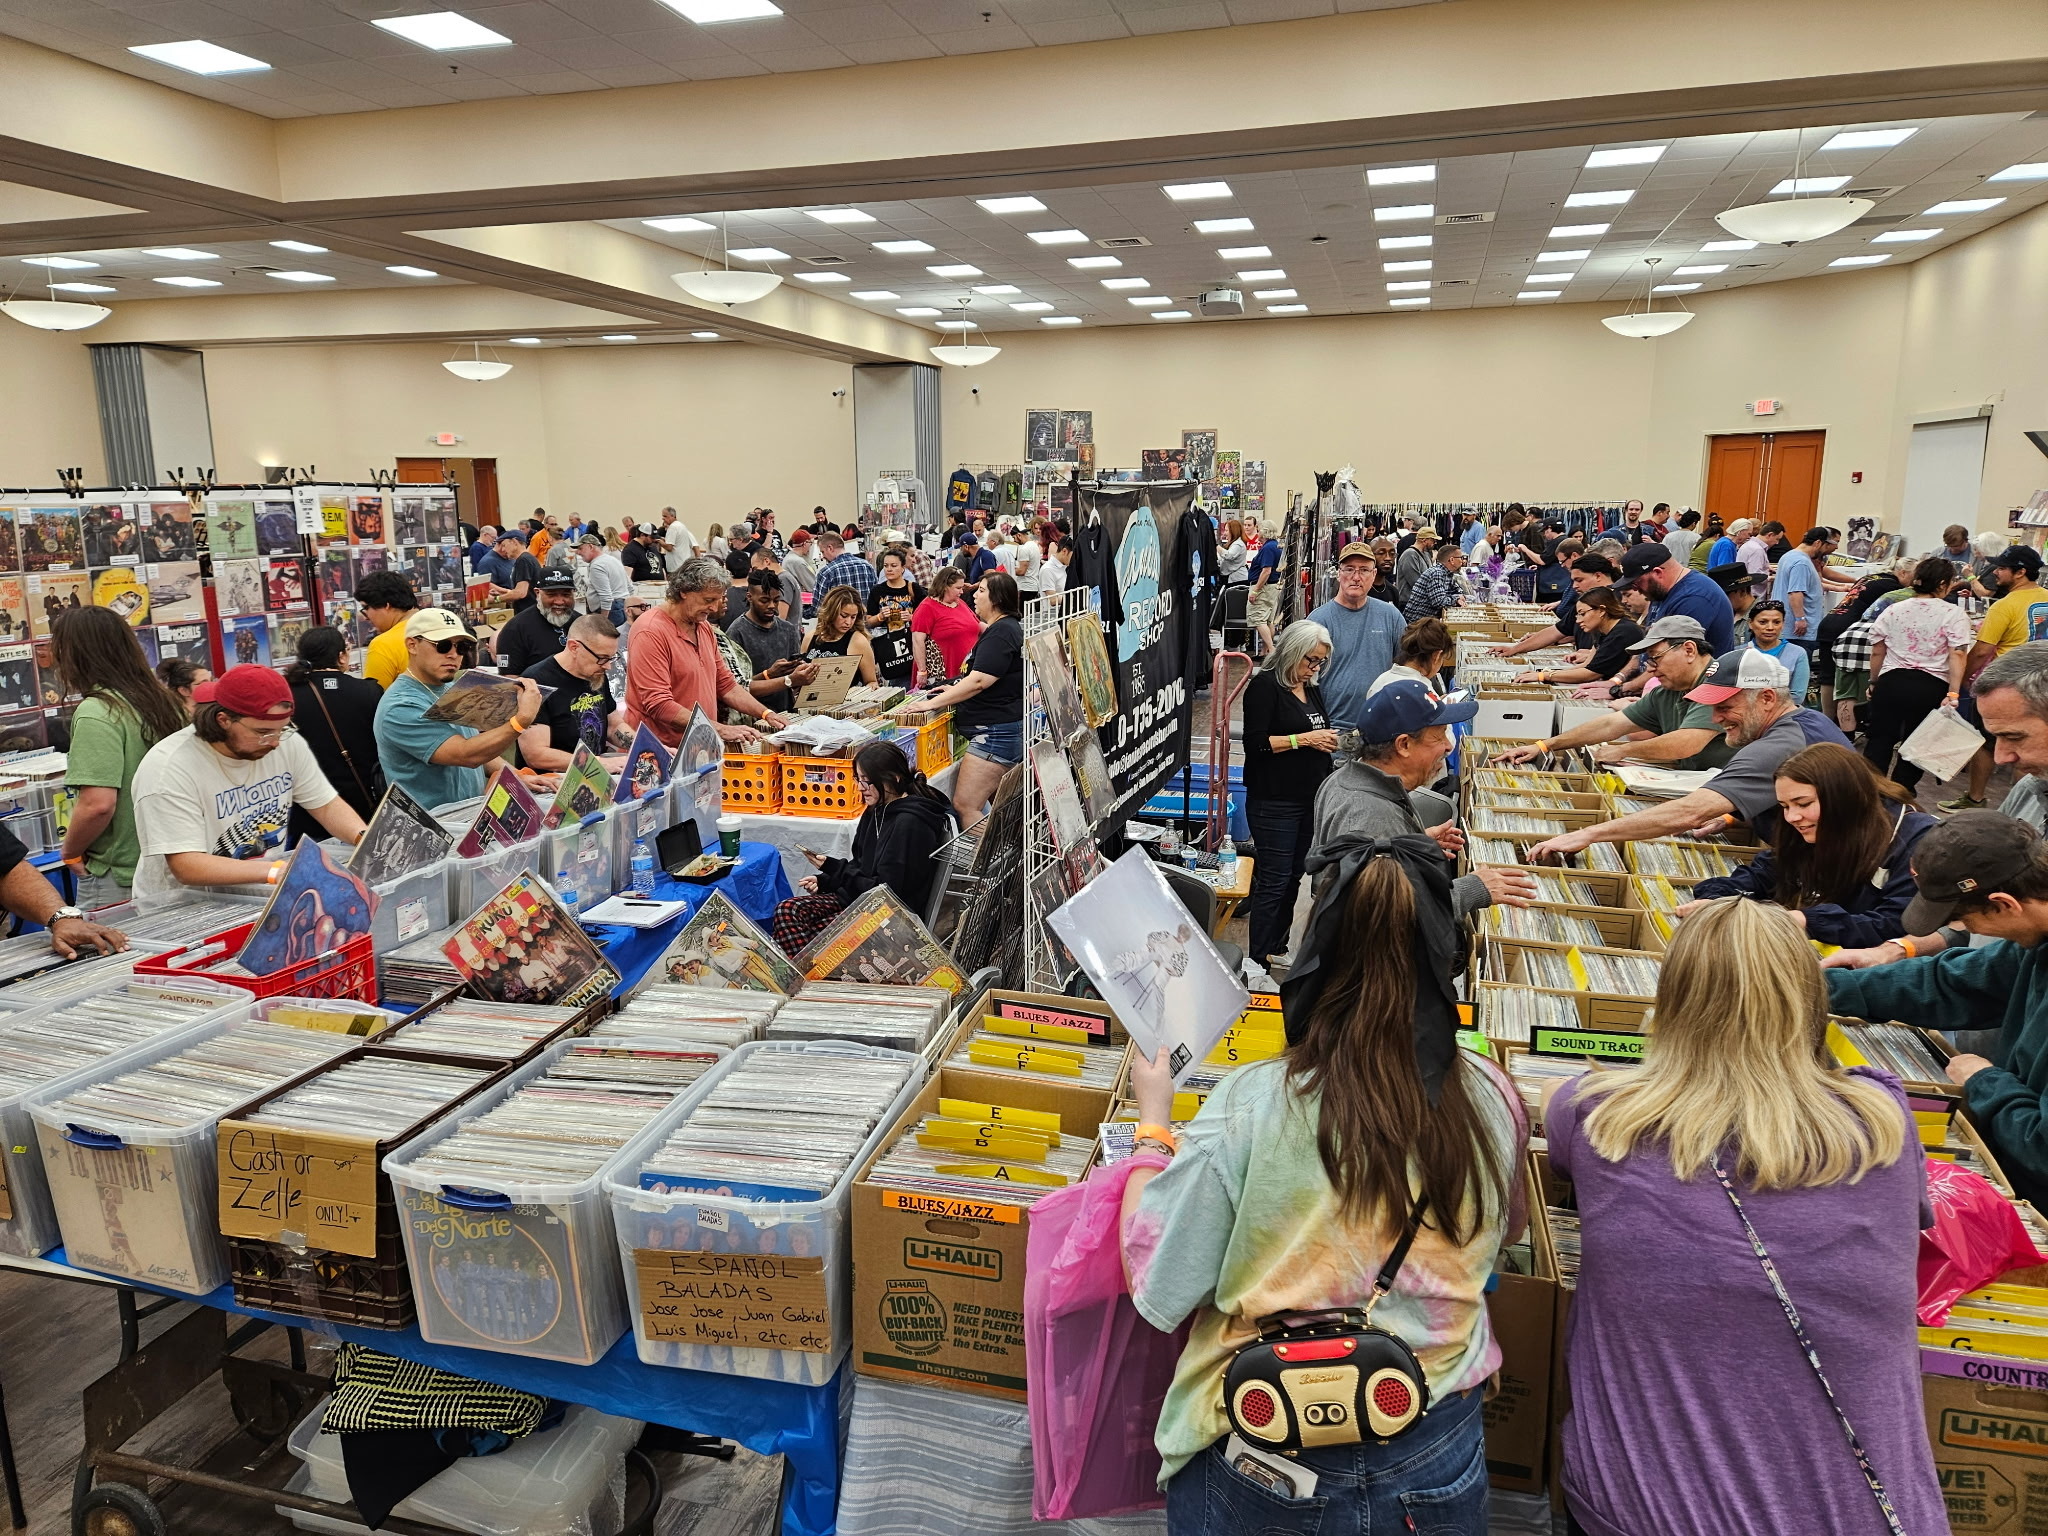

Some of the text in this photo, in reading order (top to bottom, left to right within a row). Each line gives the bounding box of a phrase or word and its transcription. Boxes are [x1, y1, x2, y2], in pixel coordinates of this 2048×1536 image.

[1758, 400, 1772, 413] EXIT
[443, 612, 455, 625] LA
[1128, 588, 1173, 632] RECORD
[1138, 621, 1165, 651] SHOP
[0, 649, 32, 658] ATLES!
[893, 638, 909, 657] E
[885, 657, 905, 667] ELTON
[467, 900, 513, 941] FRUKO
[815, 942, 850, 978] BRAVOS
[856, 904, 890, 939] NORTE
[1250, 997, 1270, 1007] ZZ
[1013, 1010, 1049, 1023] BLUES
[1061, 1019, 1093, 1030] JAZZ
[1240, 1012, 1250, 1023] Y
[1030, 1024, 1038, 1034] L
[1224, 1036, 1234, 1046] T
[1551, 1037, 1596, 1050] SOUND
[1228, 1049, 1238, 1061] S
[990, 1107, 1002, 1119] E
[979, 1127, 992, 1138] C
[229, 1129, 314, 1175] Cash or
[994, 1166, 1010, 1180] A
[228, 1177, 302, 1219] Zelle
[405, 1197, 433, 1213] Los
[898, 1195, 995, 1220] BLUES/JAZZ
[315, 1204, 349, 1223] ONLY!
[515, 1208, 539, 1217] OCHO
[413, 1217, 512, 1249] Del Norte
[910, 1243, 996, 1269] U-HAUL
[657, 1281, 773, 1301] BALADAS
[647, 1301, 680, 1317] Jose
[782, 1306, 826, 1323] Gabriel
[887, 1295, 935, 1315] 100%
[953, 1302, 1025, 1322] NEED BOXES?
[885, 1316, 943, 1330] BUY-BACK
[953, 1314, 1025, 1335] TAKE PLENTY!
[651, 1322, 687, 1337] Luis
[758, 1329, 791, 1346] etc.
[800, 1332, 828, 1349] etc.
[953, 1326, 1025, 1347] We'll Buy Bac
[953, 1338, 1009, 1356] the Extras.
[917, 1363, 988, 1382] uhaul.com
[1963, 1362, 2048, 1389] COUNTR
[1951, 1415, 2048, 1446] U-HA
[1947, 1498, 1986, 1512] RICE
